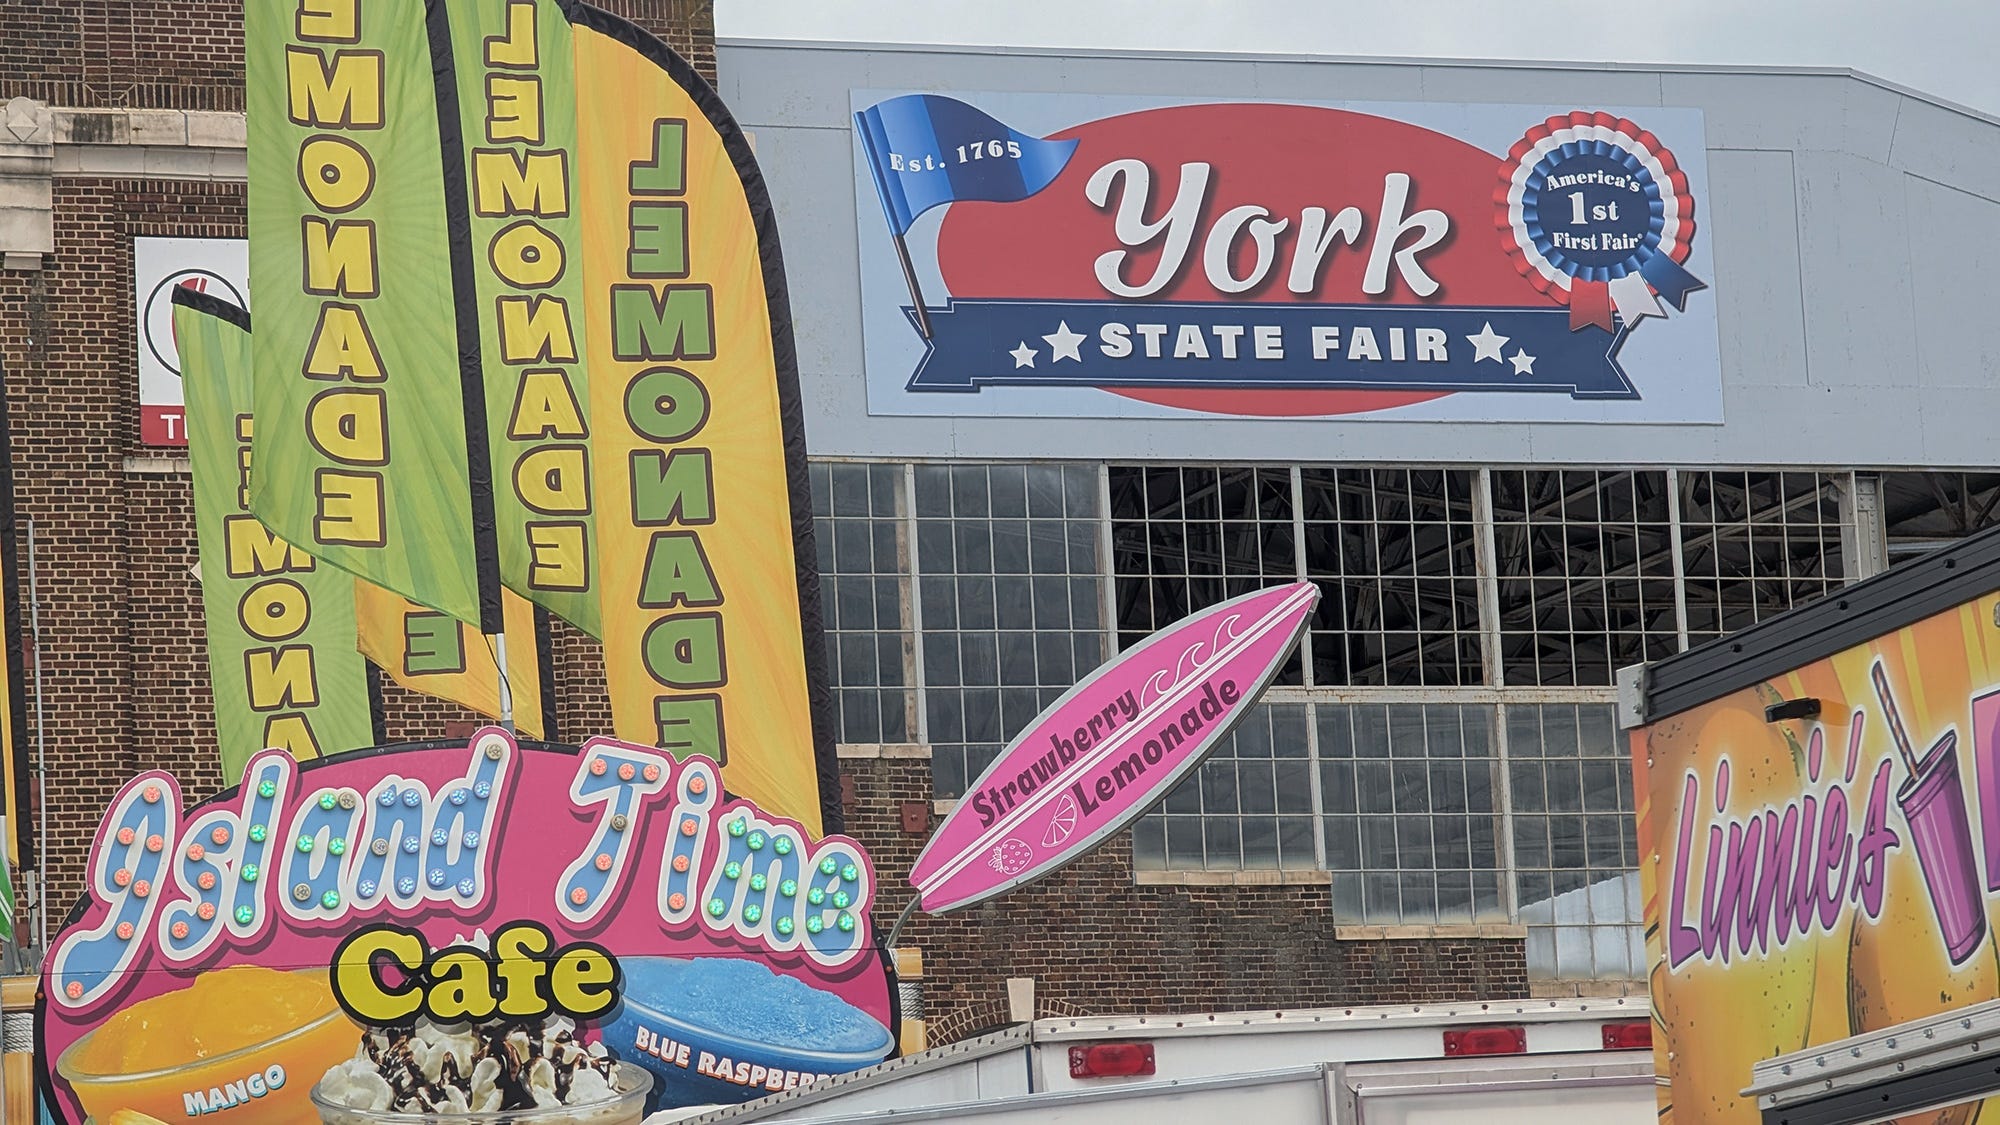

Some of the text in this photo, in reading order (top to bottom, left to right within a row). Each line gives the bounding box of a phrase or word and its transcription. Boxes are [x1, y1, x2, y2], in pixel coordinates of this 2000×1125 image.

[888, 139, 1022, 173] Est. 1765
[1546, 169, 1640, 192] America's
[1084, 158, 1449, 299] York
[1552, 232, 1598, 250] First
[1099, 321, 1449, 361] STATE FAIR
[971, 686, 1139, 830] Strawberry
[1074, 676, 1241, 818] Lemonade
[51, 729, 874, 1008] Island Time
[1668, 709, 1900, 971] Linnie's
[331, 921, 622, 1024] Cafe
[635, 1025, 691, 1068] BLUE
[182, 1064, 287, 1116] MANGO
